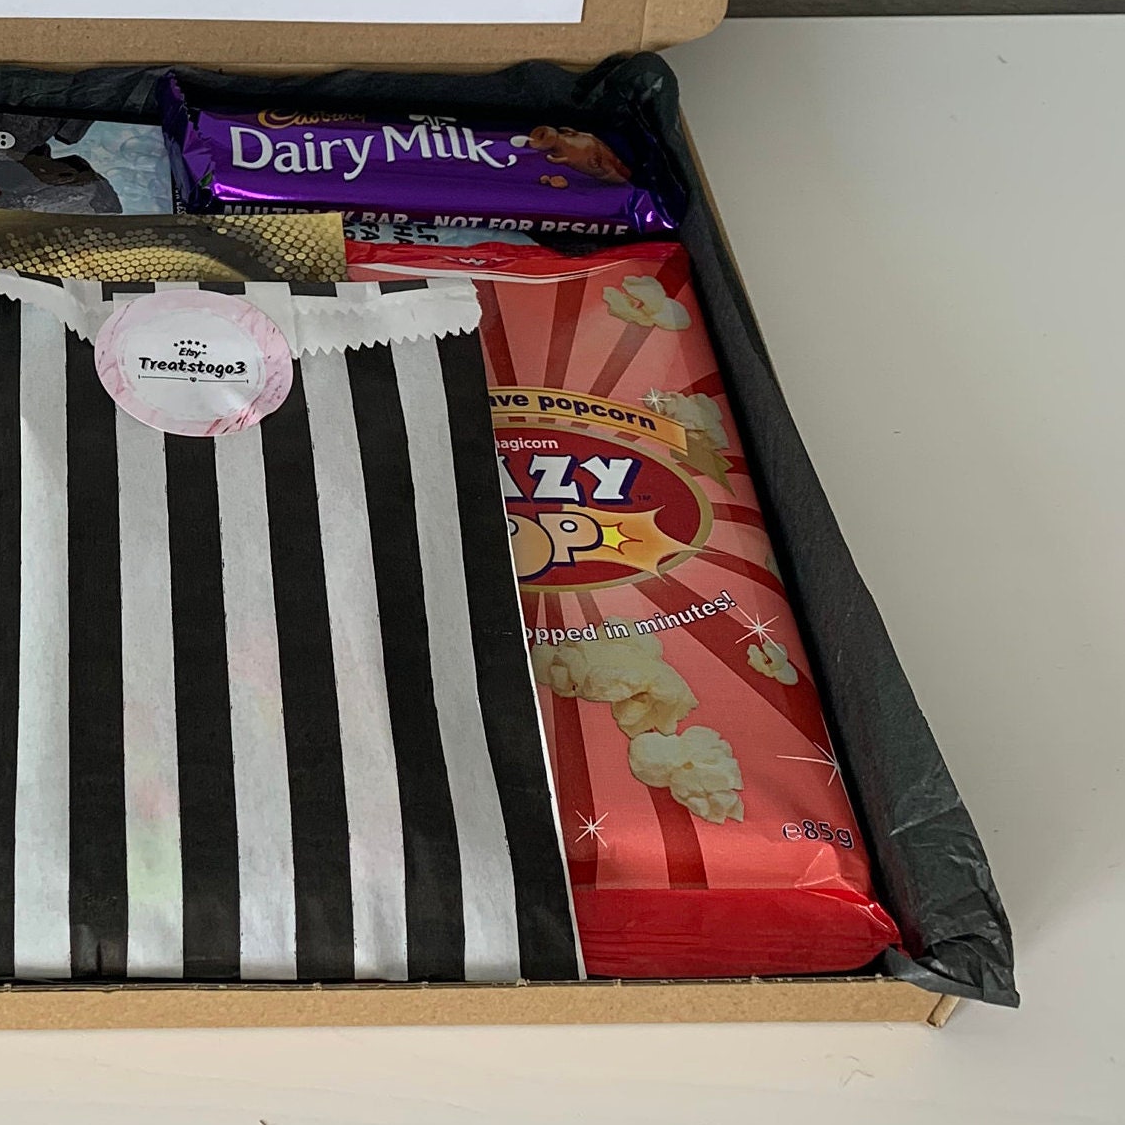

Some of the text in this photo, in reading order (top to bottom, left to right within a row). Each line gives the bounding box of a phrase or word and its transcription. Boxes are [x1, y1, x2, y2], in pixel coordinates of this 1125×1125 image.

[228, 118, 511, 181] Dairy Milk
[362, 211, 408, 225] BAR
[434, 215, 483, 227] NOT
[487, 218, 531, 231] FOR
[540, 221, 629, 236] RESALE
[138, 356, 247, 379] Treatstogo3
[537, 395, 657, 432] popcorn
[495, 437, 559, 452] agicorn
[506, 512, 603, 581] OP
[525, 590, 737, 646] opped in minutes!
